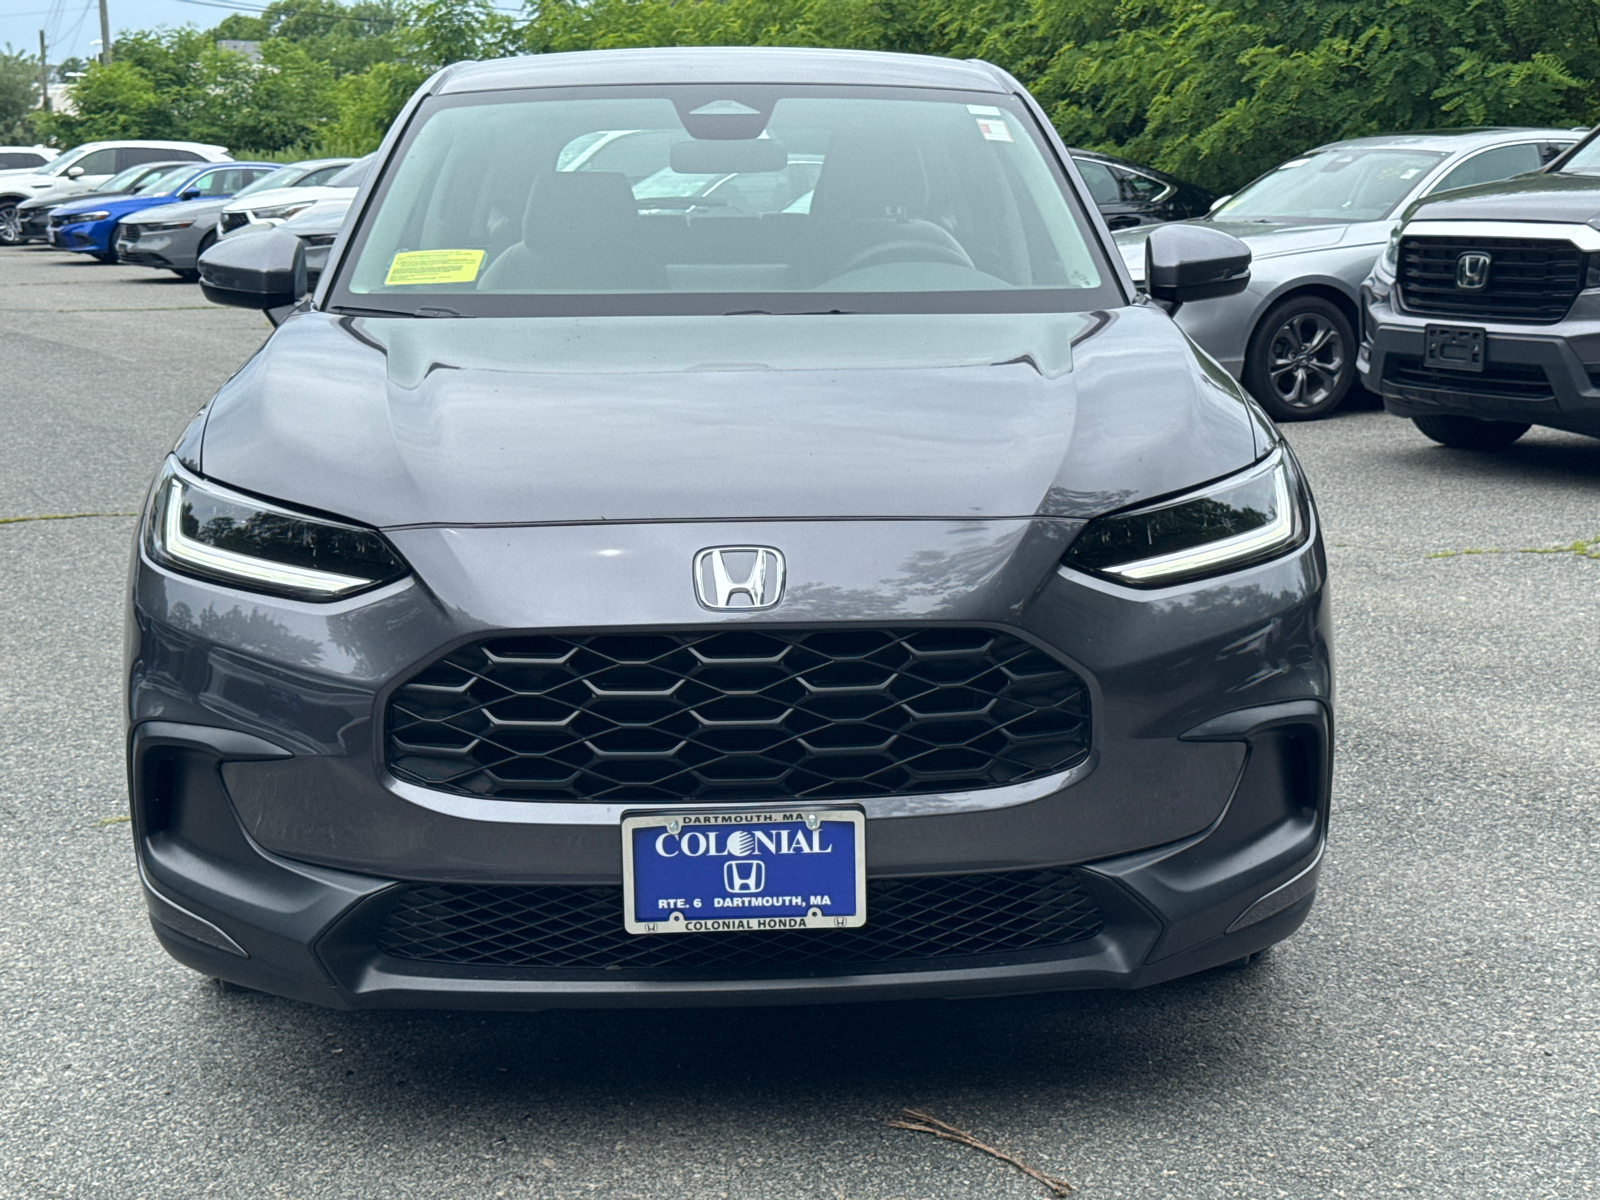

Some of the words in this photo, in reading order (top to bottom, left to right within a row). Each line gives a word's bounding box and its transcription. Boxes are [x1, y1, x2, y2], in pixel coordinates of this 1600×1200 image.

[682, 814, 778, 824] DARTMOUTH,
[782, 812, 804, 821] MA
[655, 828, 833, 858] COLONIAL
[657, 898, 690, 909] RTE.
[693, 897, 703, 909] 6
[713, 896, 807, 908] DARTMOUTH,
[809, 895, 832, 906] MA
[685, 918, 754, 931] COLONIAL
[757, 917, 807, 929] HONDA
